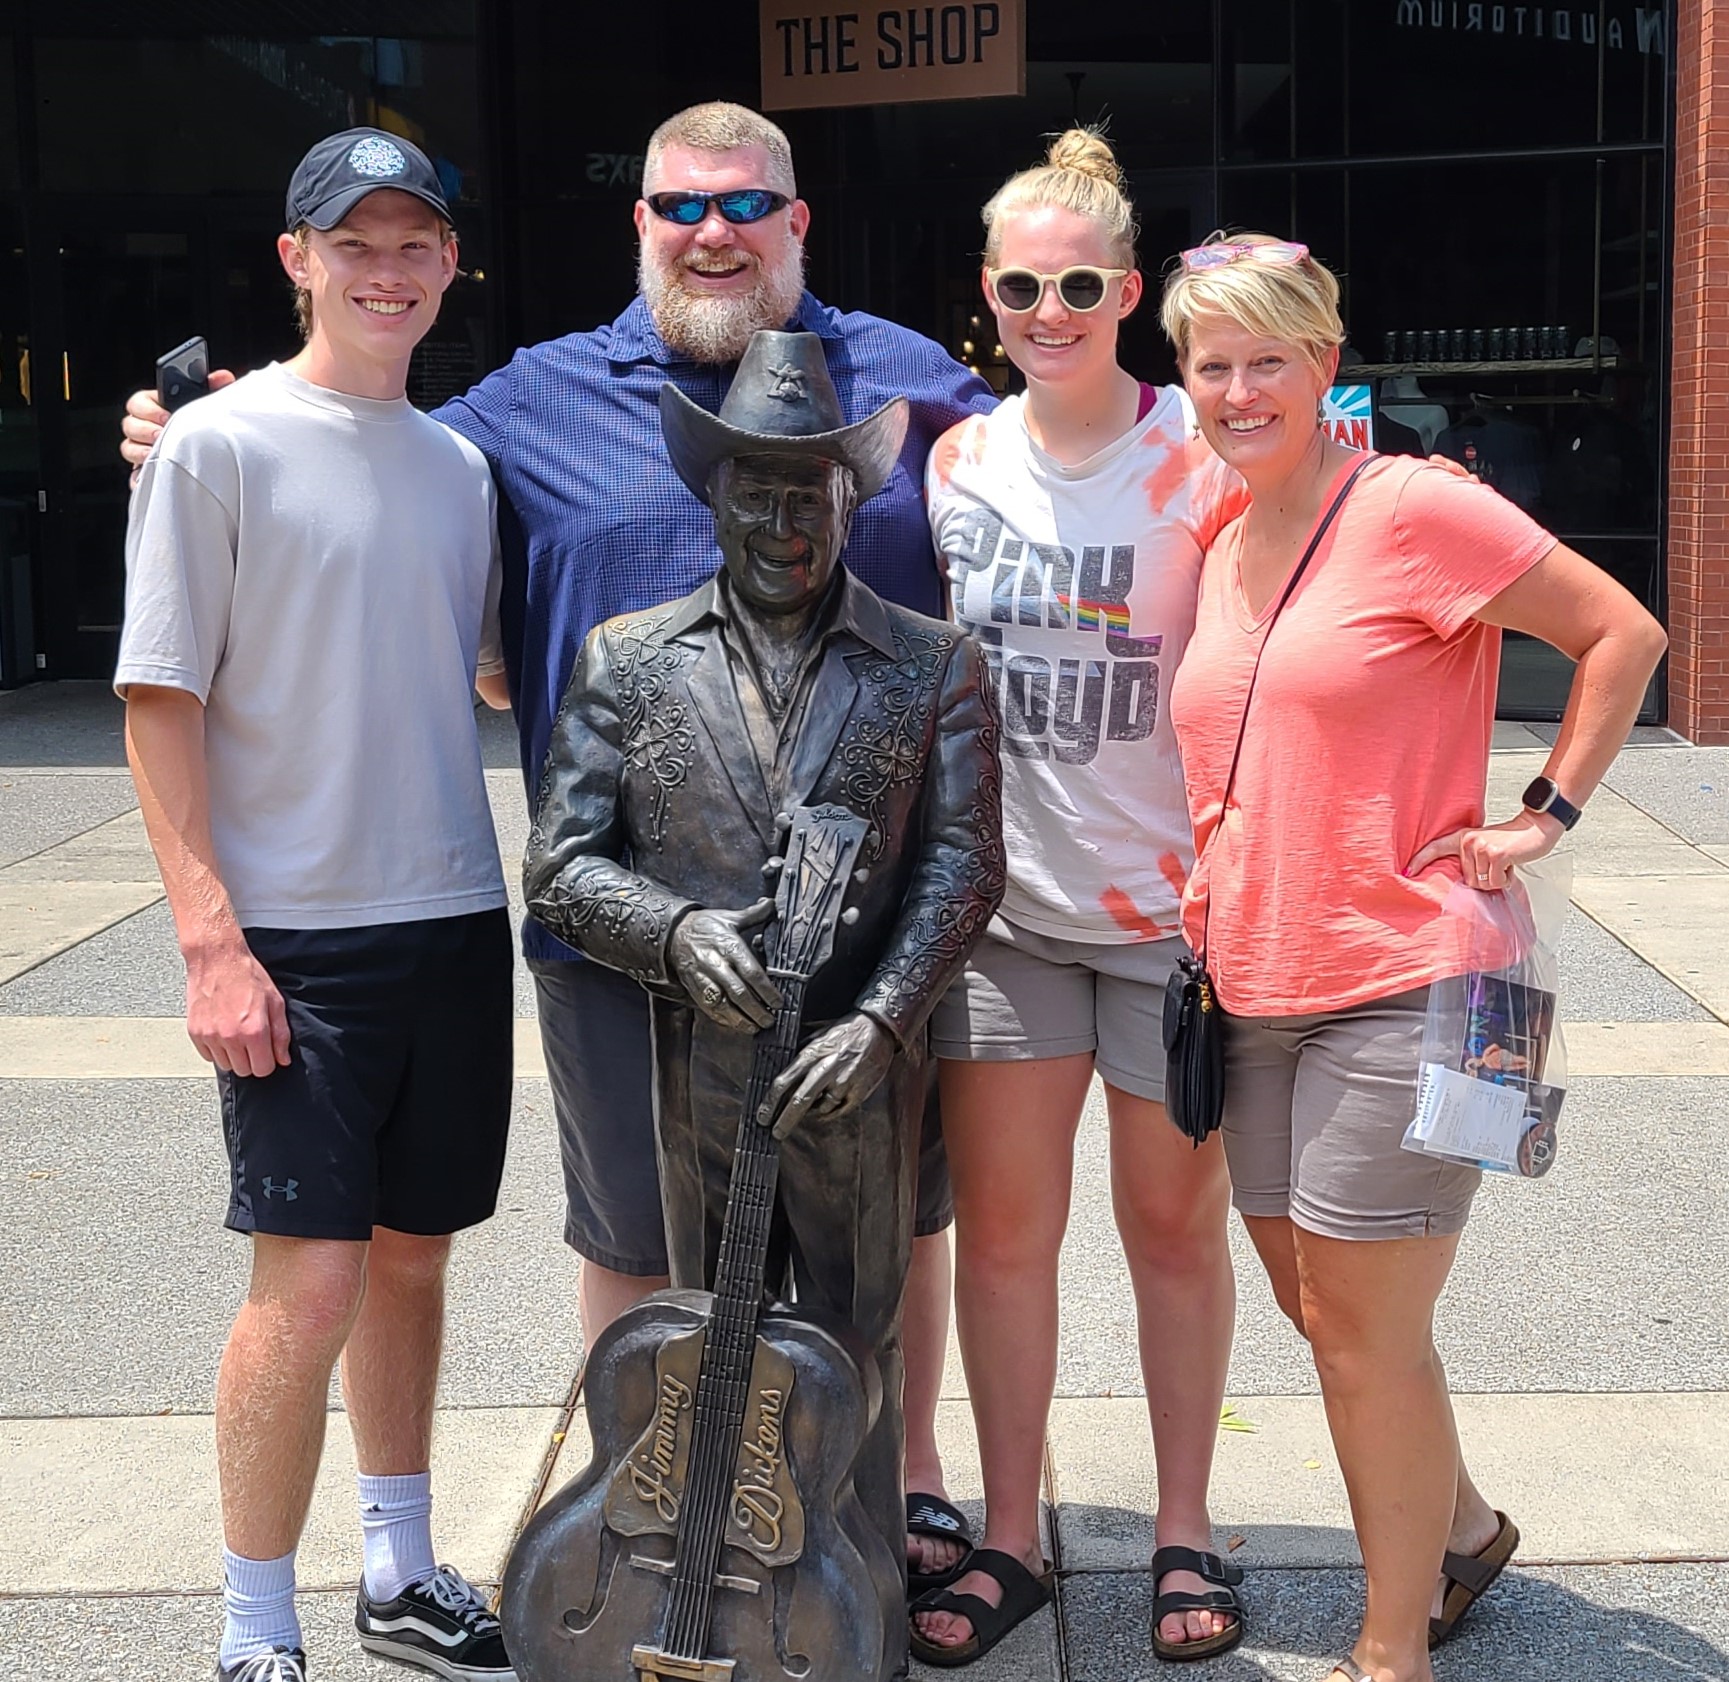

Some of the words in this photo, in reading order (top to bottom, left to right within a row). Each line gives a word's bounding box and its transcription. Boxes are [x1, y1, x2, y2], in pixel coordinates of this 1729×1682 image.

[776, 14, 860, 76] THE
[877, 3, 1000, 70] SHOP
[627, 1374, 693, 1523] Jimmy
[731, 1389, 784, 1551] Dickens
